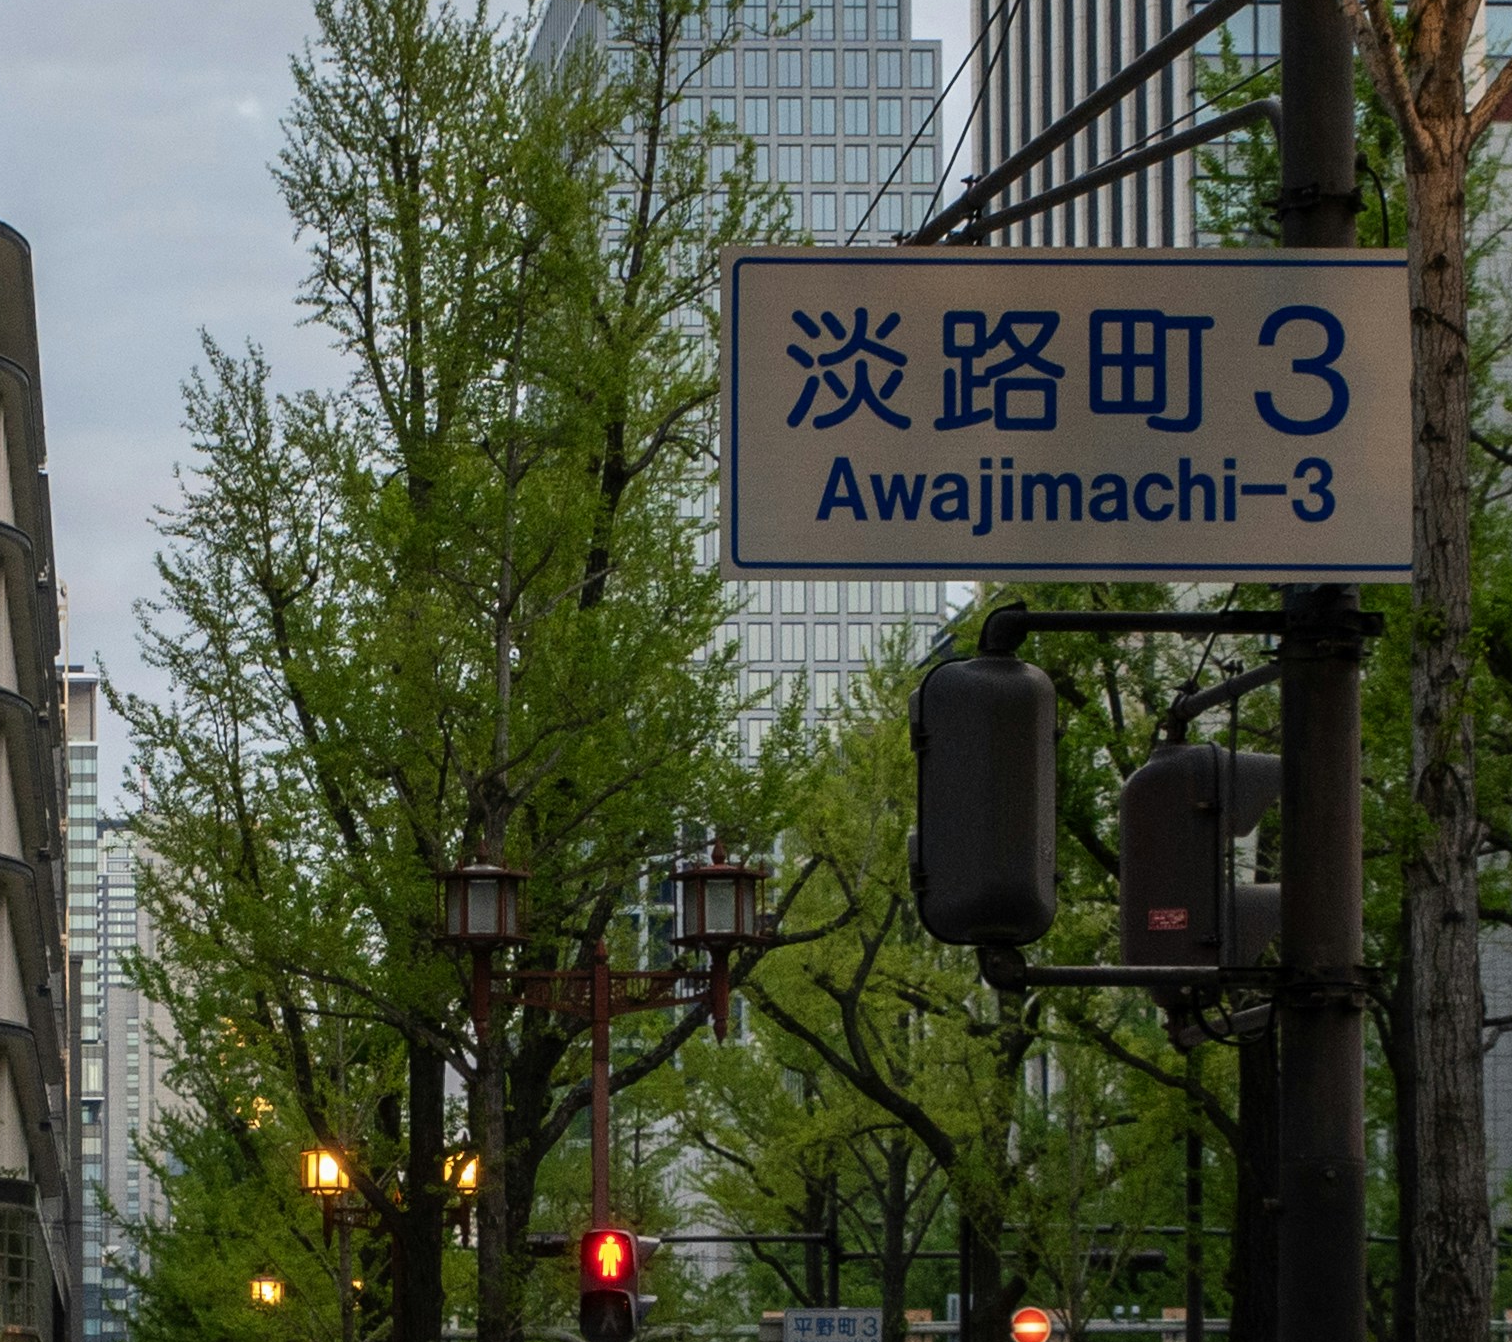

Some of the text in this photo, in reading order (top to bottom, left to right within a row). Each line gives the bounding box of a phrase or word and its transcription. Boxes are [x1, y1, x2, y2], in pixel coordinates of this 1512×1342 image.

[786, 303, 1351, 436] 淡路町3
[814, 455, 1337, 537] Awajimachi-3
[793, 1316, 878, 1337] 平野町3
